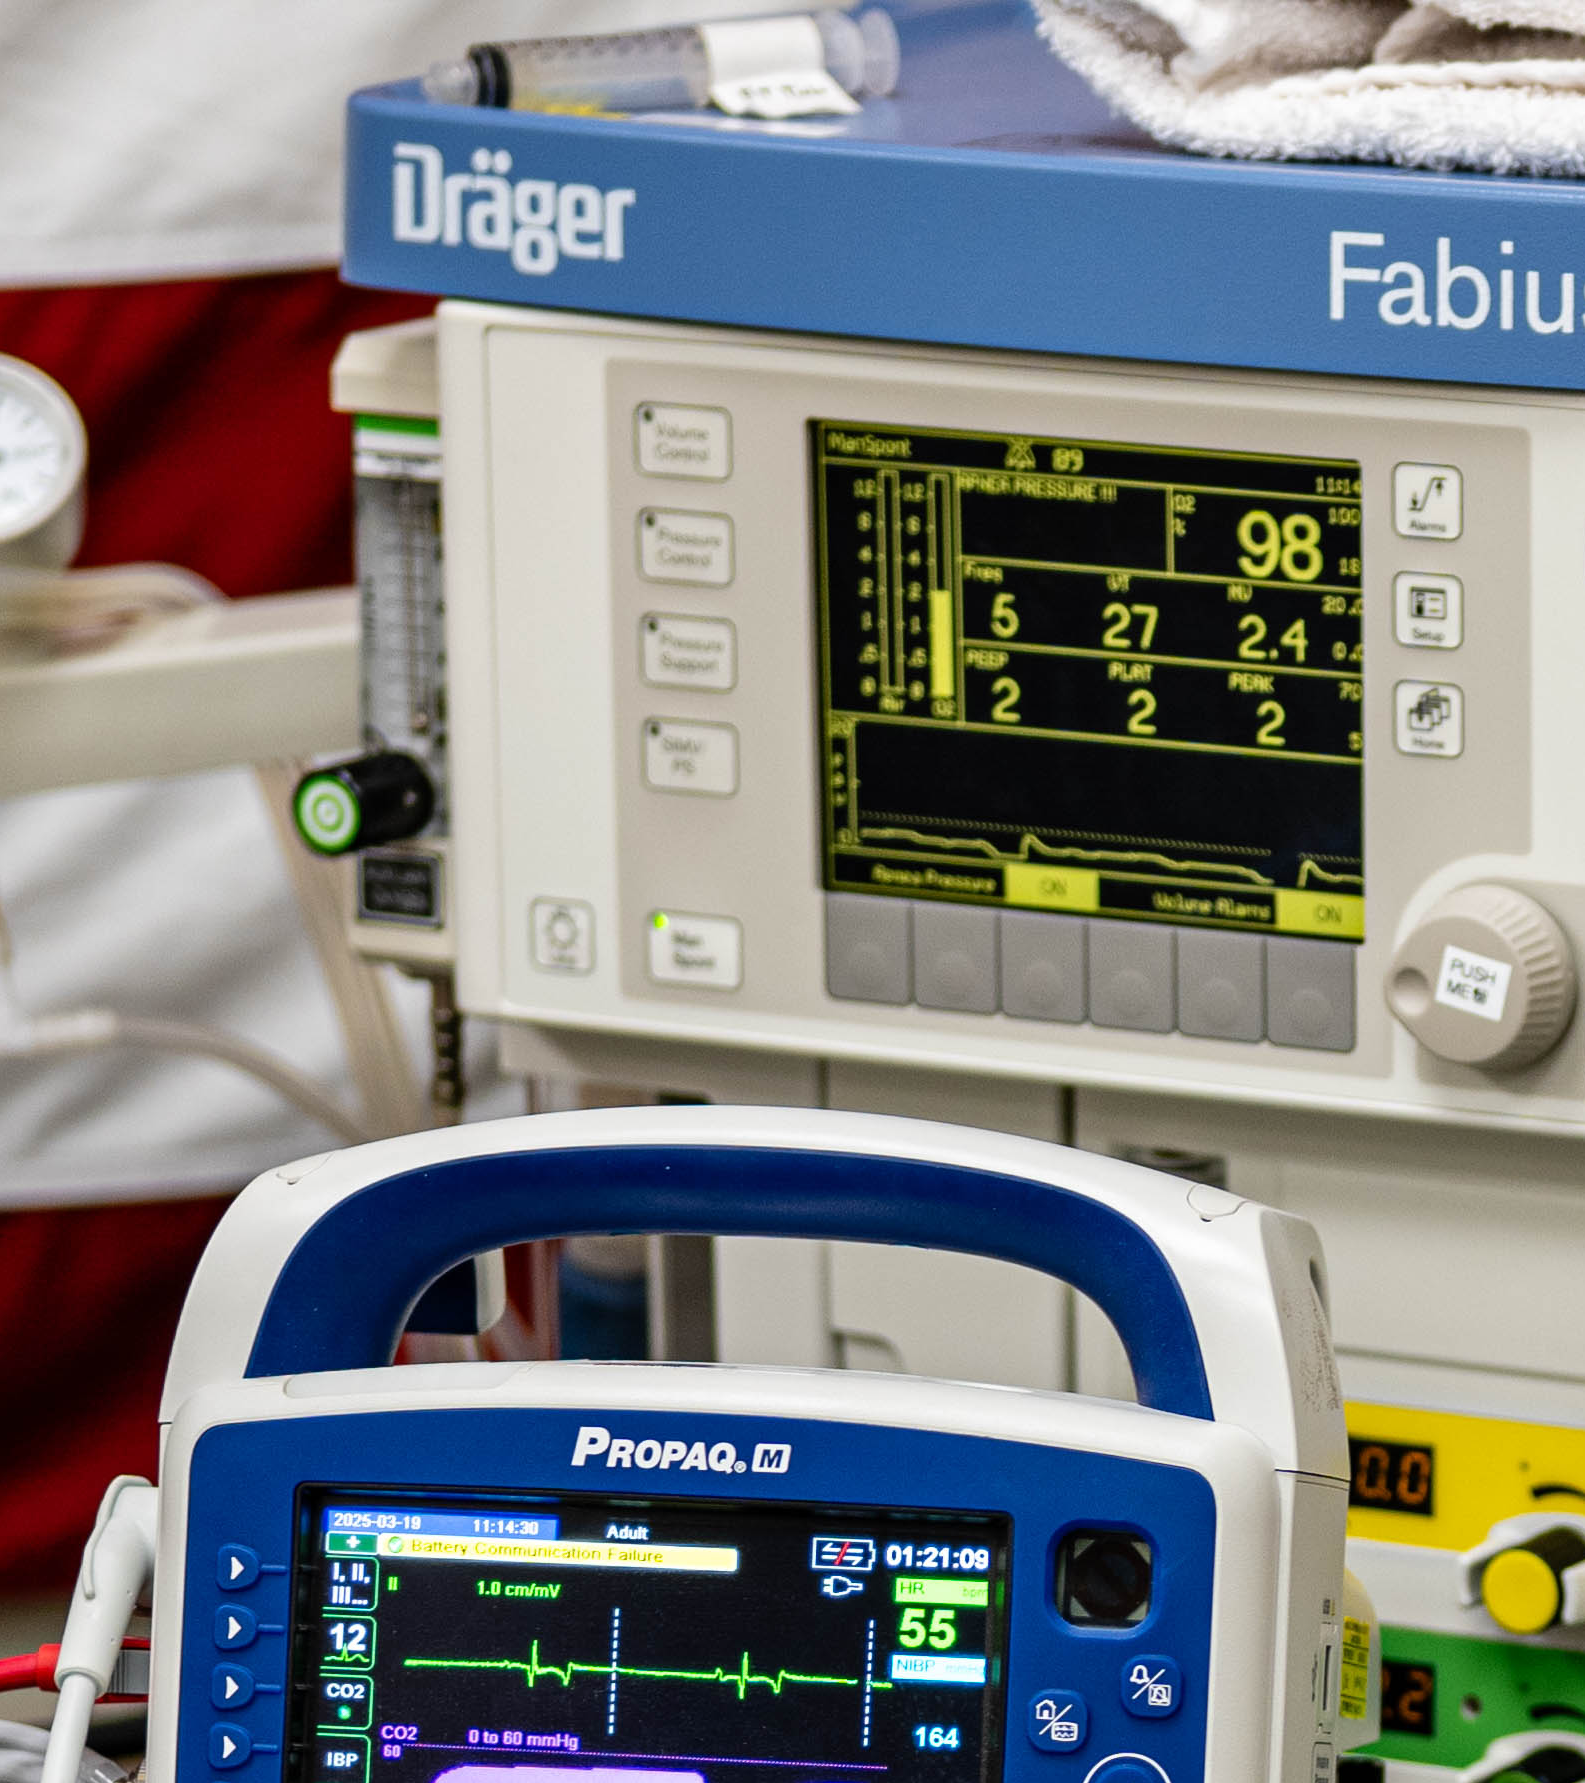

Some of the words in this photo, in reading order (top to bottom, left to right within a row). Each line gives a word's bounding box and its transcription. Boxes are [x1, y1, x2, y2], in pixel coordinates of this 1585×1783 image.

[393, 142, 635, 275] Dräger
[1016, 480, 1098, 502] PRESSURE
[1237, 510, 1323, 582] 98
[990, 592, 1020, 638] 5
[1103, 602, 1159, 650] 27
[1238, 614, 1308, 663] 2.4
[1228, 672, 1275, 694] PEAK
[991, 677, 1021, 723] 2
[1127, 689, 1157, 735] 2
[1256, 700, 1286, 746] 2
[1449, 957, 1497, 986] PUSH
[1446, 978, 1473, 1002] ME
[334, 1512, 422, 1530] 2025-03-19
[473, 1518, 539, 1536] 11:14:30
[607, 1525, 649, 1541] Adult
[412, 1539, 468, 1556] Battery
[475, 1541, 601, 1561] Communication
[608, 1547, 664, 1564] Failure
[886, 1545, 989, 1569] 01:21:09
[477, 1580, 502, 1596] 1.0
[504, 1582, 561, 1599] cm/mV
[900, 1581, 926, 1596] HR
[329, 1623, 366, 1651] 12
[898, 1608, 957, 1649] 55
[896, 1658, 936, 1673] NIBP
[326, 1683, 365, 1699] CO2
[380, 1725, 418, 1741] CO2
[468, 1729, 479, 1744] 0
[482, 1730, 499, 1745] to
[503, 1731, 523, 1747] 60
[527, 1734, 579, 1751] mmHg
[915, 1726, 959, 1748] 164
[326, 1752, 358, 1768] IBP
[383, 1745, 401, 1758] 60
